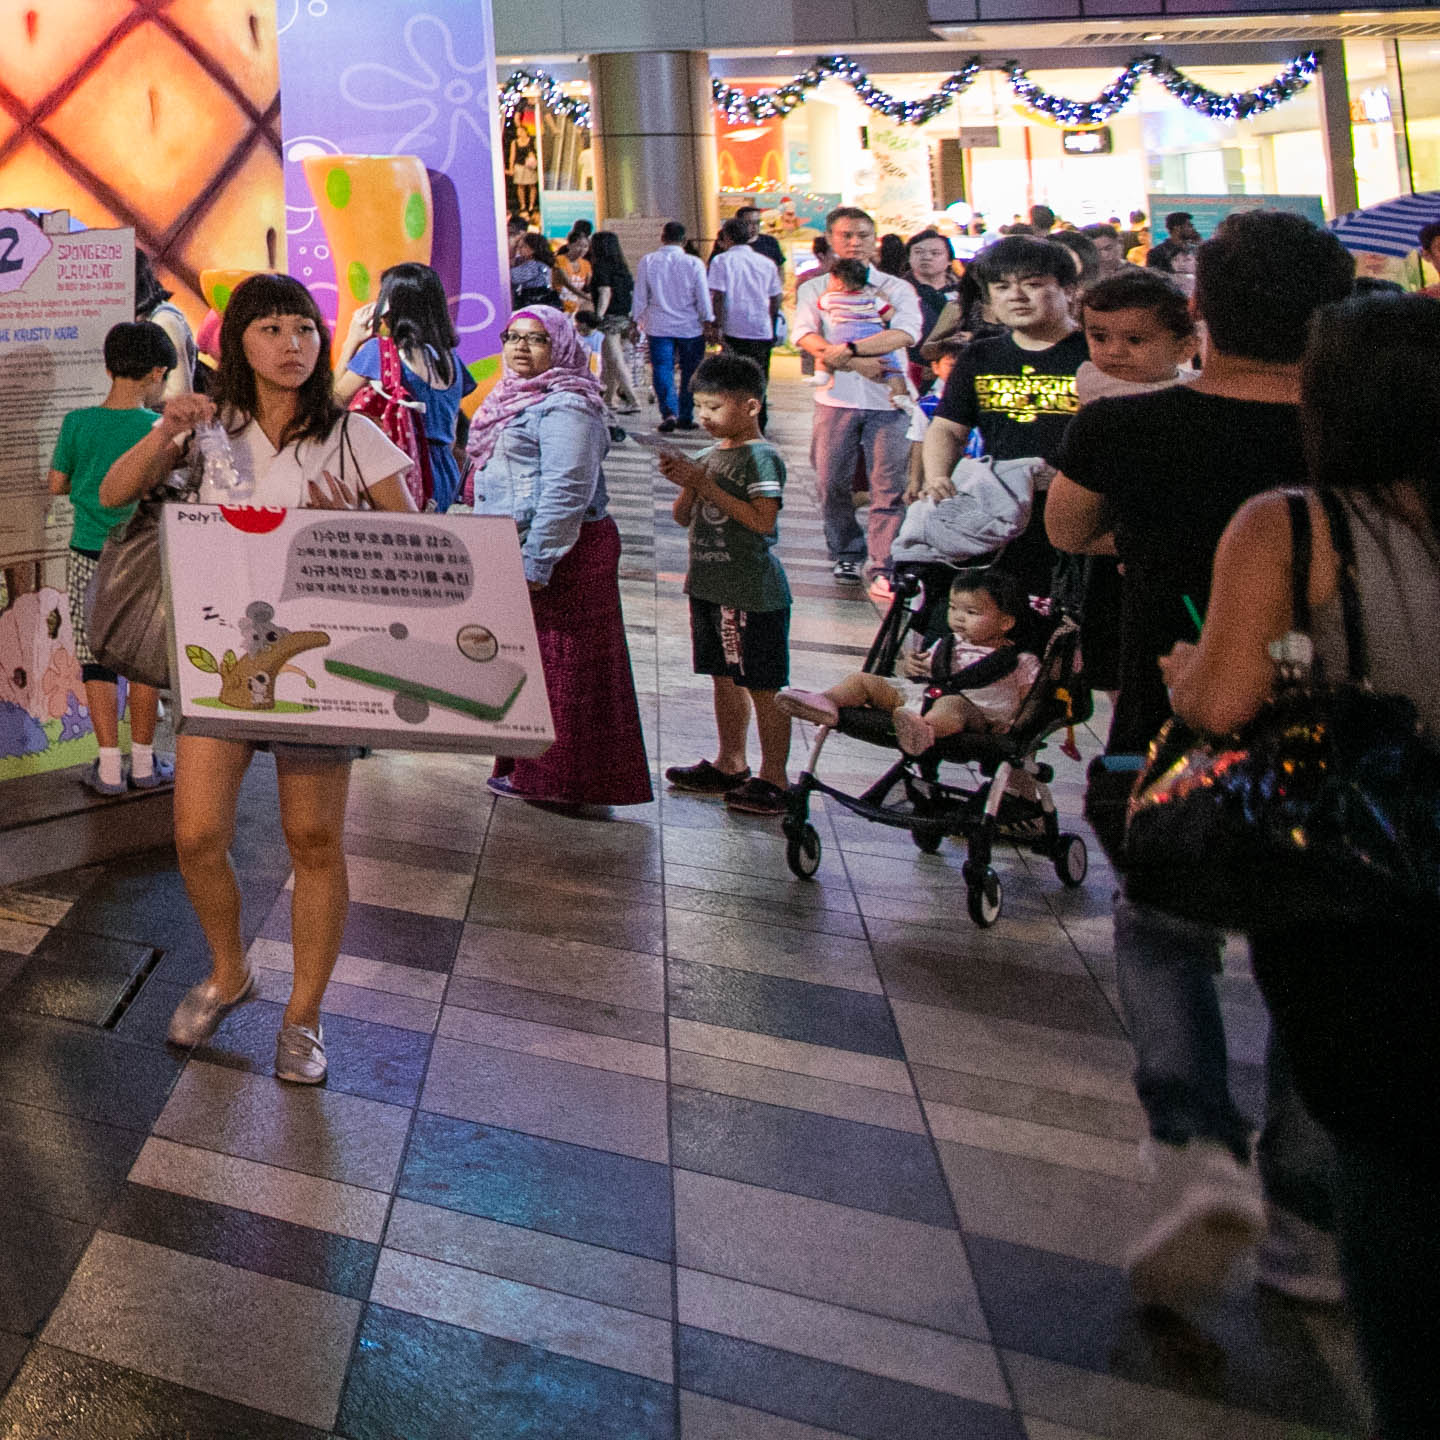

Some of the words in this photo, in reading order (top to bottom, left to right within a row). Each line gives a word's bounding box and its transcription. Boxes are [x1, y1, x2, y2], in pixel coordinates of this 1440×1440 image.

[57, 244, 122, 261] SPONGEBOB
[57, 263, 113, 279] PLAYLAND
[14, 327, 51, 341] KRUSTY
[53, 326, 79, 340] KRAB
